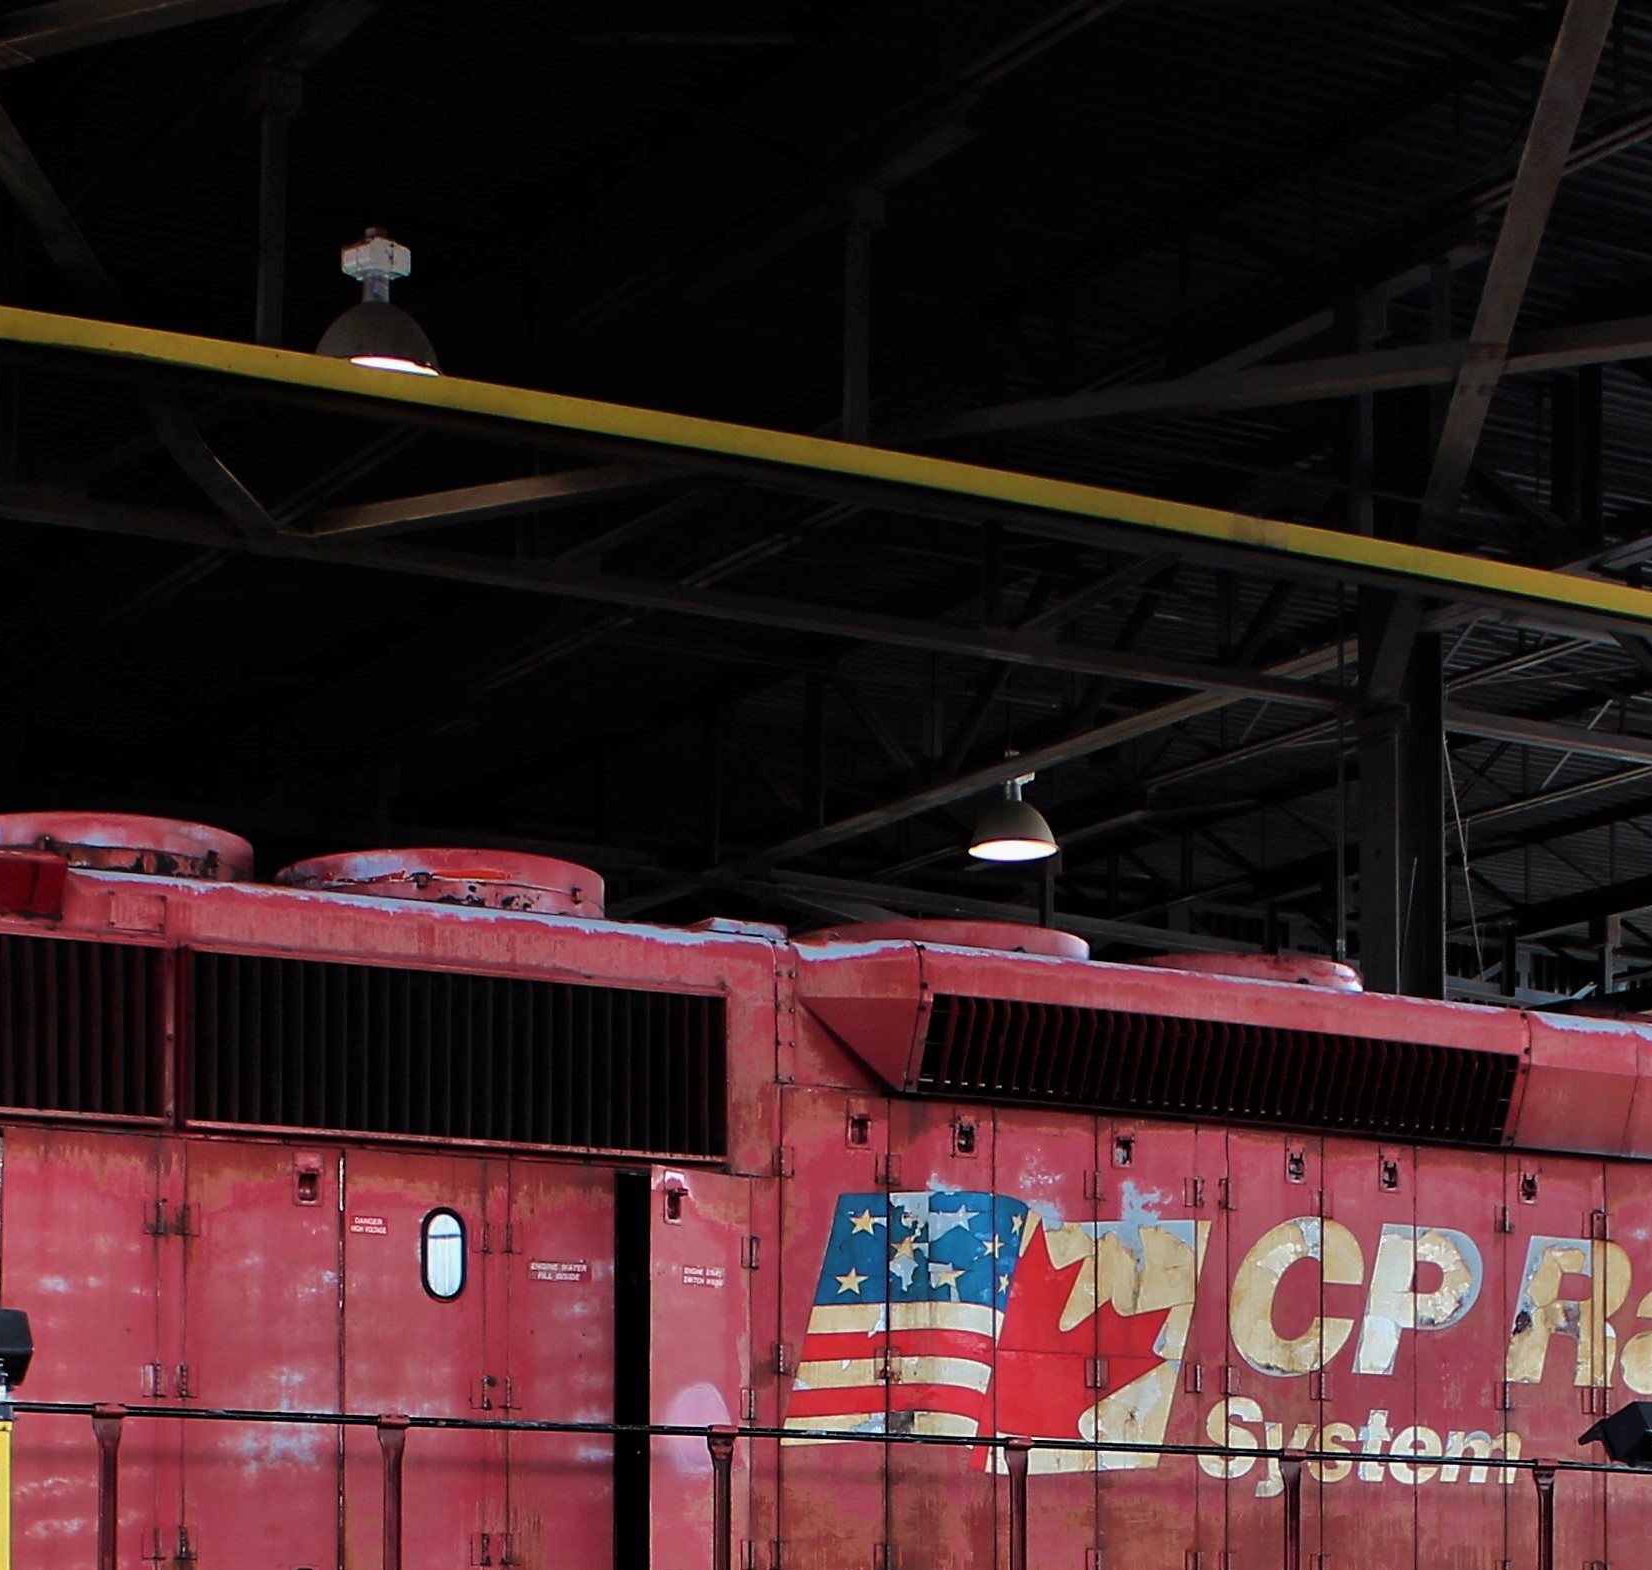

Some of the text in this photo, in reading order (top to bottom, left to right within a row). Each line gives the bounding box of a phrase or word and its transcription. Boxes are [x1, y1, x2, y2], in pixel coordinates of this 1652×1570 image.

[354, 1216, 383, 1225] DANGER
[350, 1224, 387, 1234] HIGH VOLTAGE
[530, 1262, 587, 1273] ENGINE WATER
[1230, 1215, 1484, 1378] CP
[1196, 1396, 1523, 1498] System
